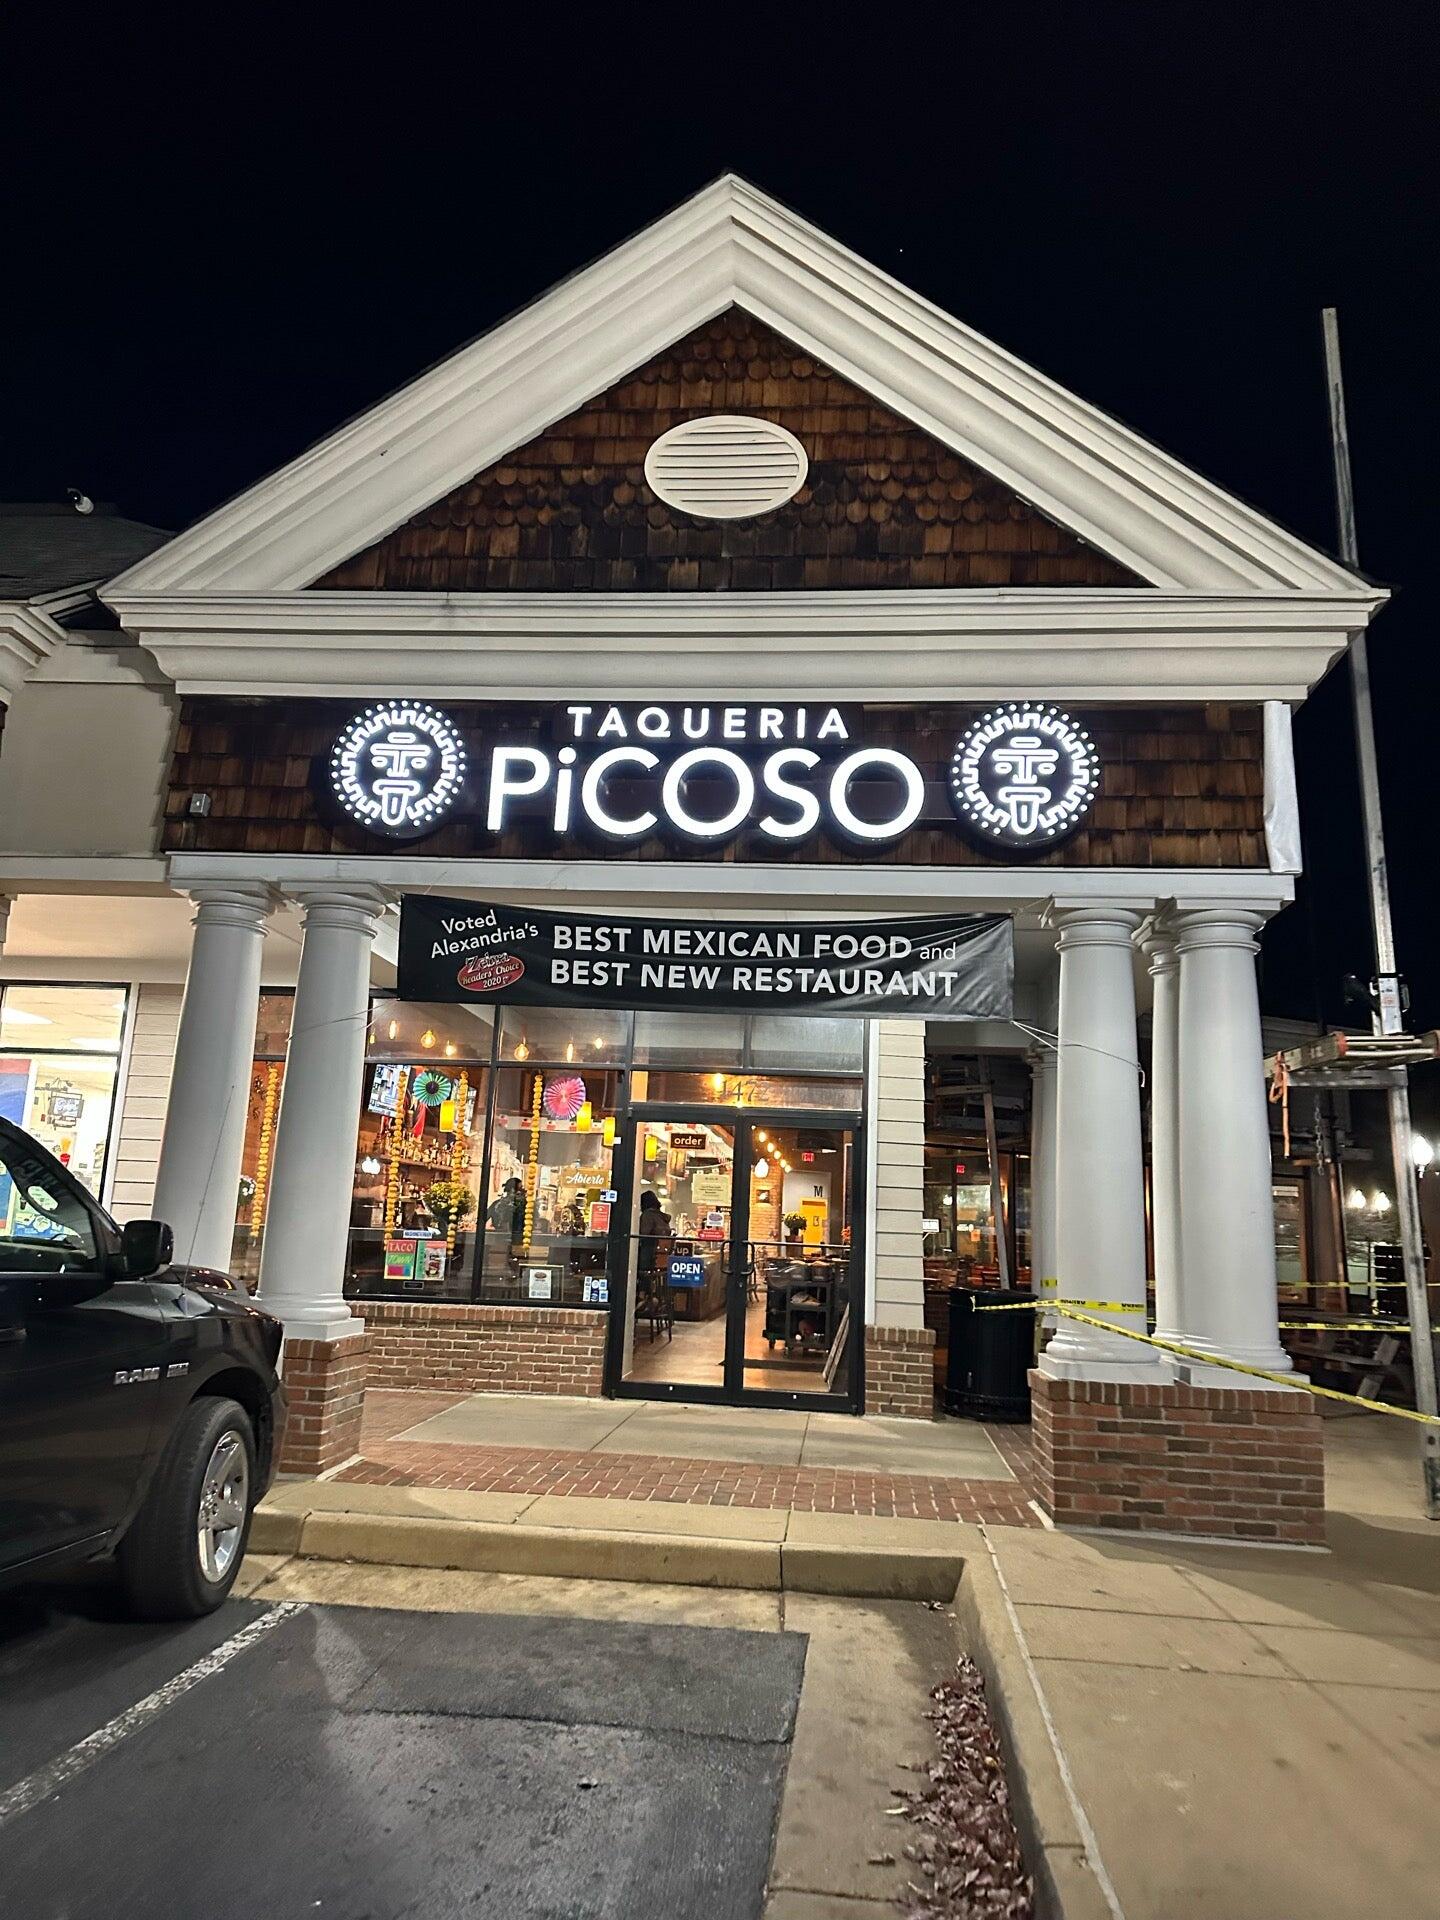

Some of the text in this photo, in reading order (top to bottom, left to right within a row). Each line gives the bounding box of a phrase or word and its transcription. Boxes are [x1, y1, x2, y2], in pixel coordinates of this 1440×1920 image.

[567, 707, 849, 739] TAQUERIA
[487, 746, 925, 838] PiCOSO
[441, 908, 497, 934] Voted
[431, 922, 539, 958] Alexandria's
[552, 925, 957, 961] BEST MEXICAN FOOD and
[495, 962, 520, 975] Choice
[483, 975, 502, 988] 2020
[550, 958, 956, 996] BEST NEW RESTAURANT
[674, 1133, 703, 1146] order
[565, 1171, 605, 1185] Abierto
[813, 1185, 824, 1198] M
[389, 1242, 414, 1252] TACO
[676, 1247, 689, 1256] up
[671, 1262, 701, 1274] OPEN
[114, 1366, 160, 1385] RAM
